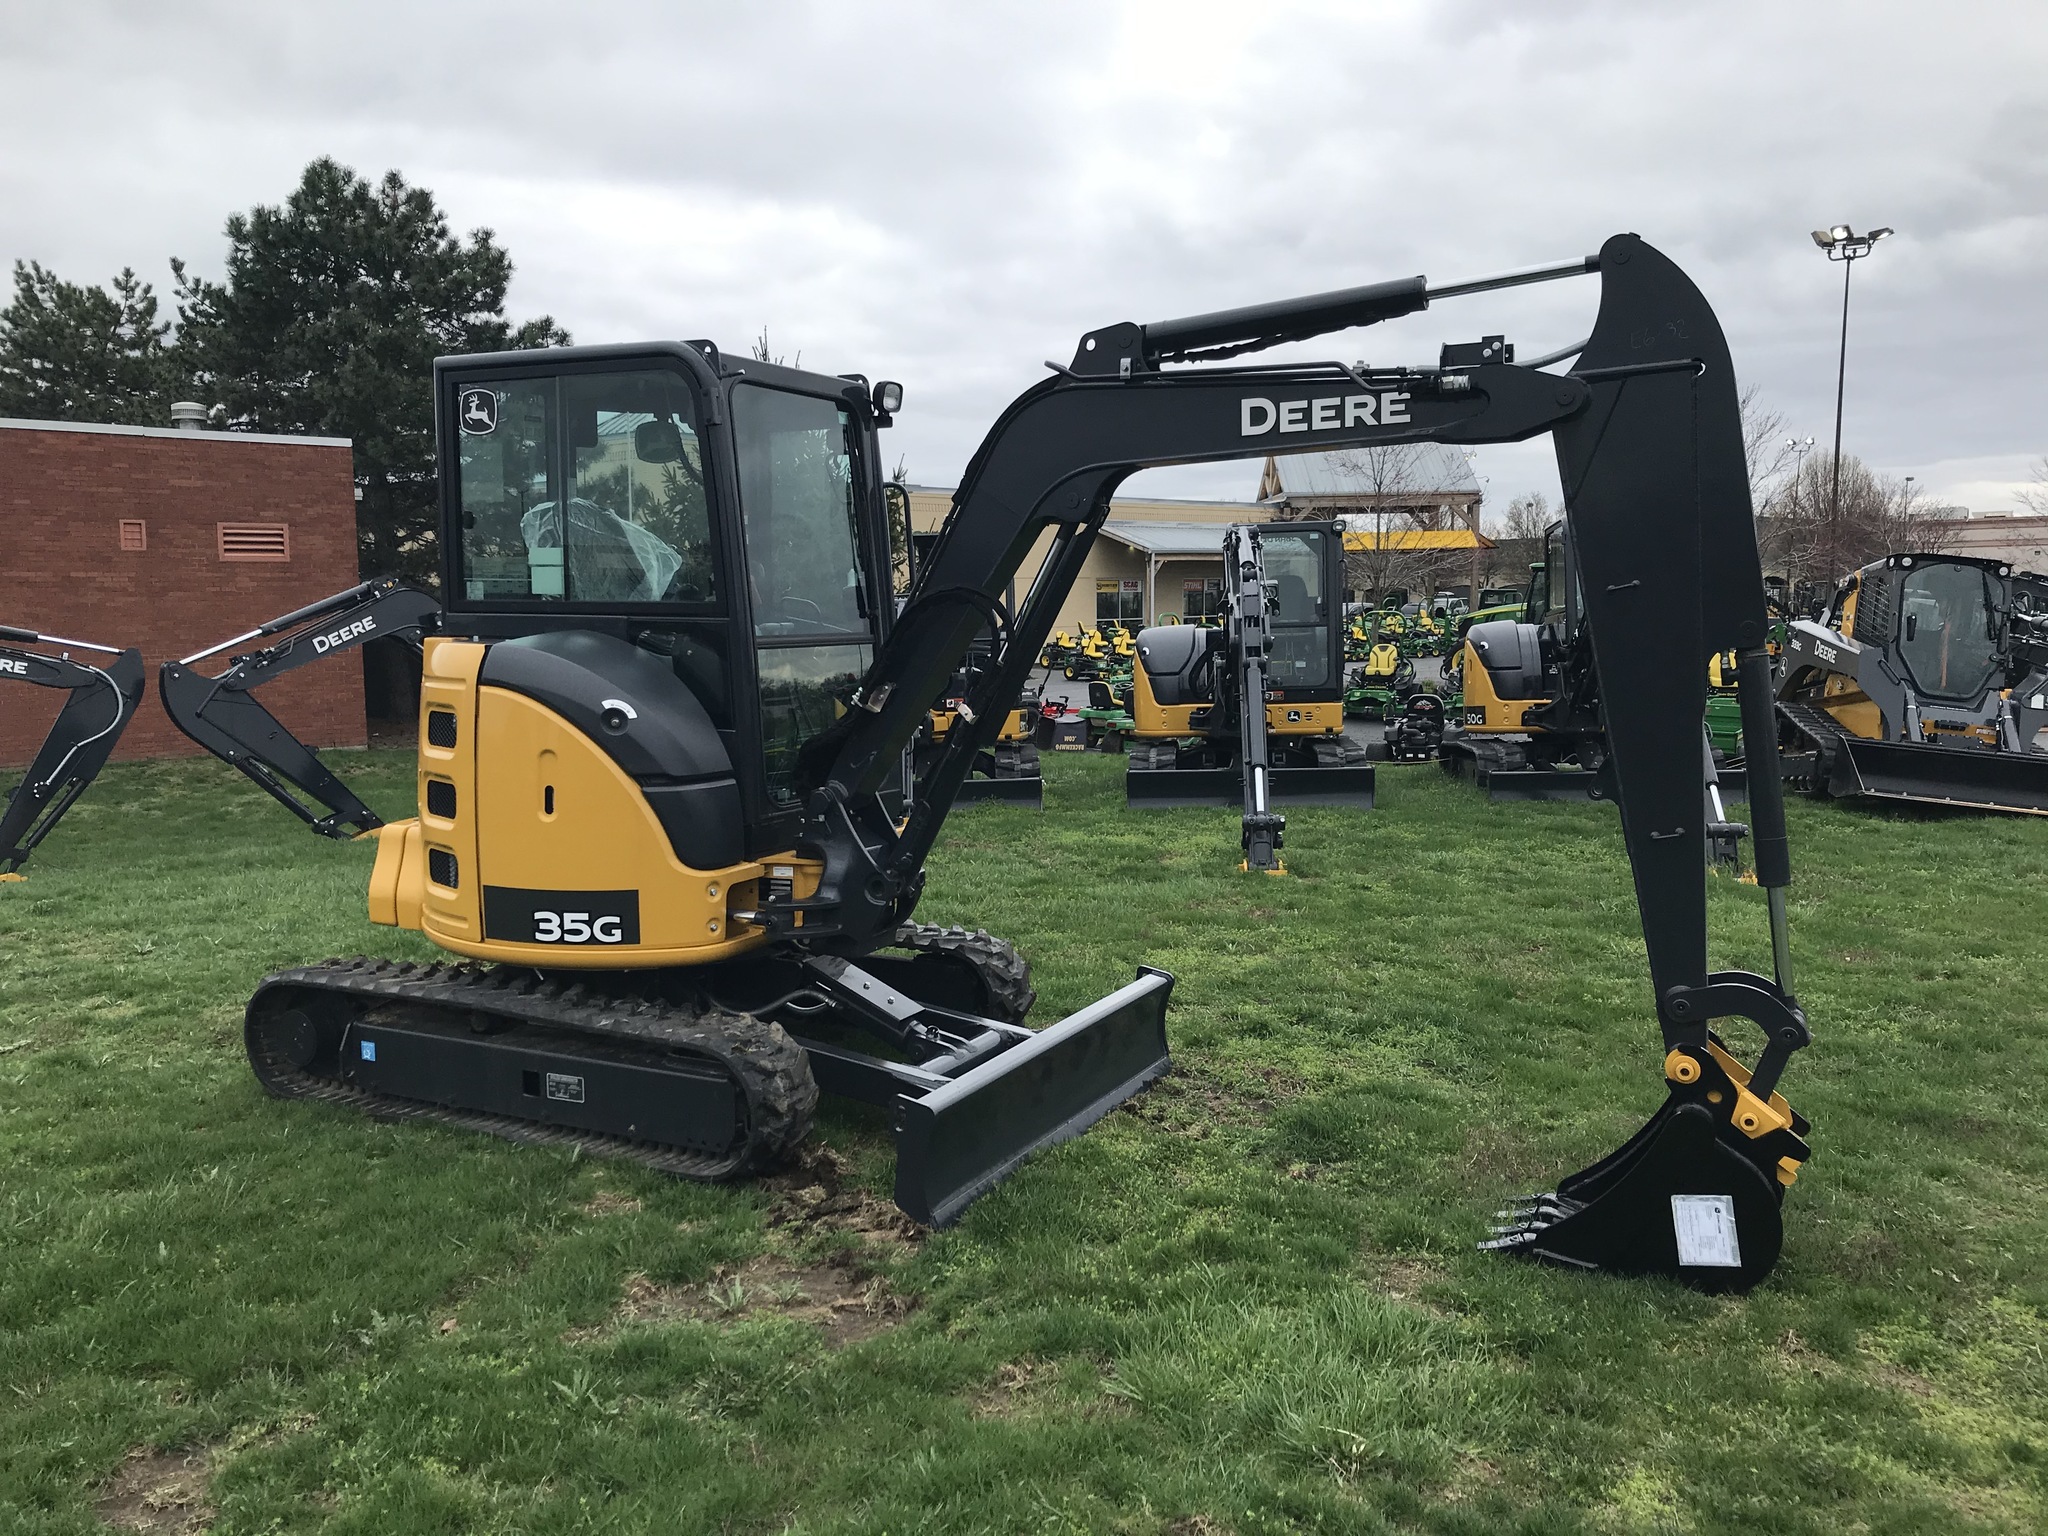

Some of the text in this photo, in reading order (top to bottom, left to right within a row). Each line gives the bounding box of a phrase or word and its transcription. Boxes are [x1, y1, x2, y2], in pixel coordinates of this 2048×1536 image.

[1241, 391, 1412, 437] DEERE
[1184, 581, 1202, 590] STIHL
[311, 615, 377, 654] DEERE
[1813, 639, 1838, 664] DEERE
[533, 911, 622, 943] 35G
